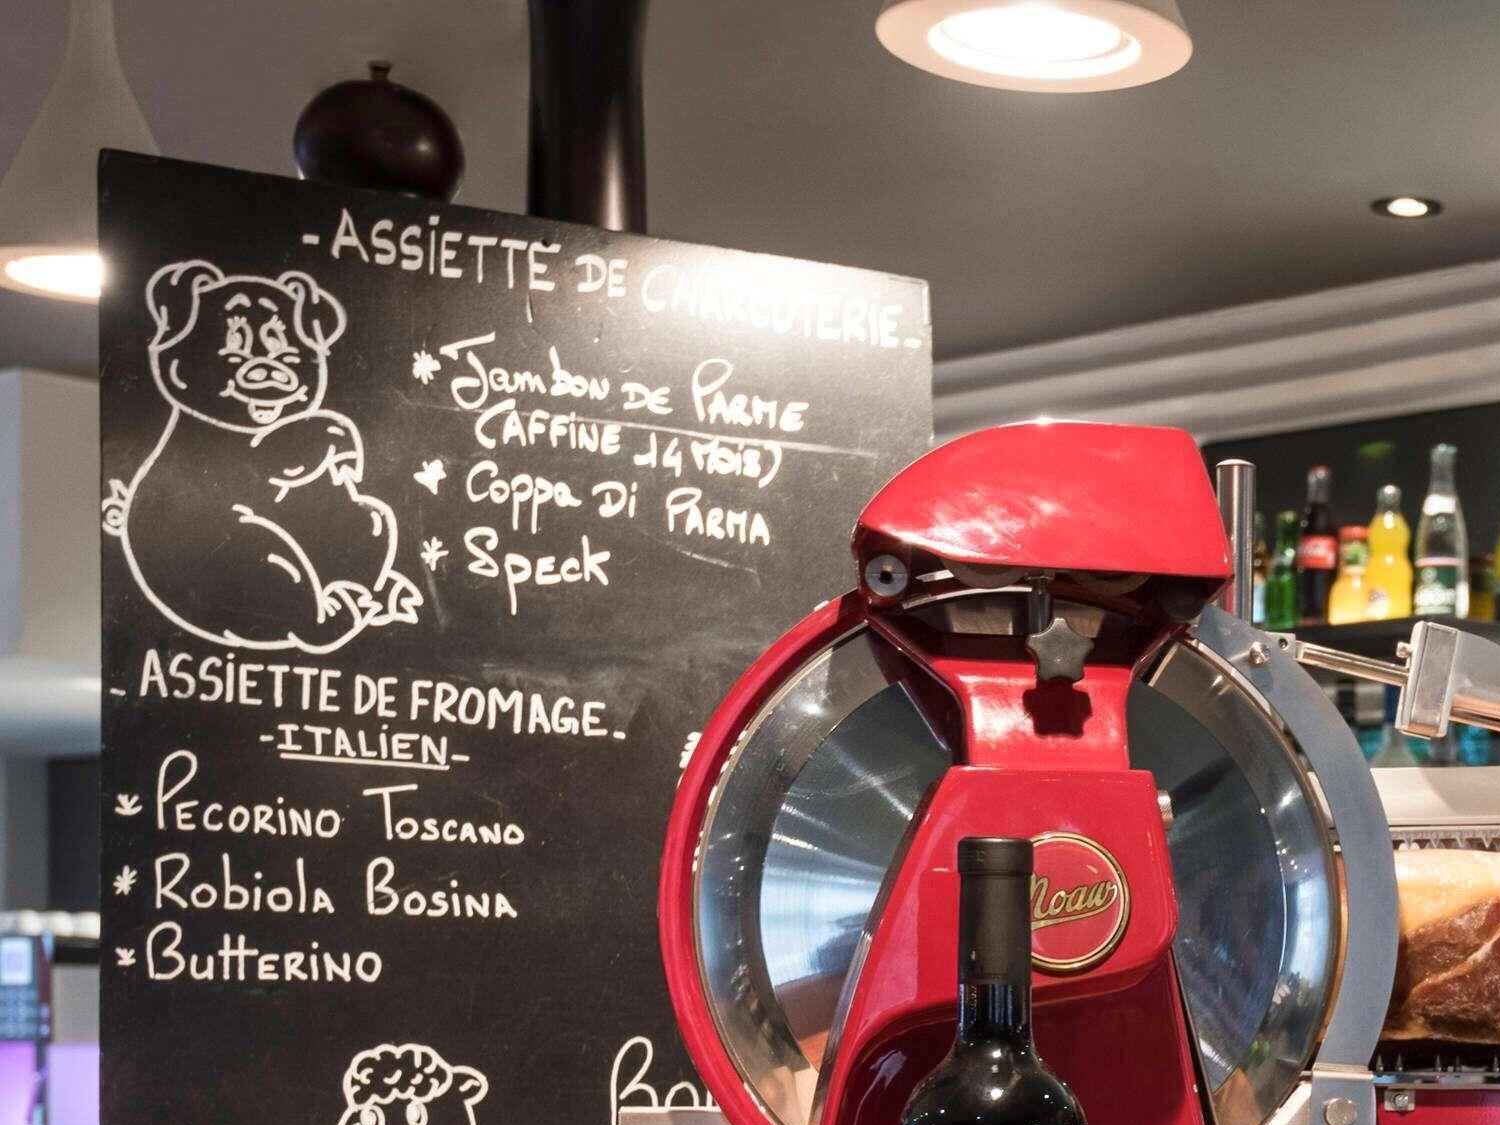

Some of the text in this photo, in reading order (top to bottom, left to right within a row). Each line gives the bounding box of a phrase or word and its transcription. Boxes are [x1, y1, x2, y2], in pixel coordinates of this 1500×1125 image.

[574, 254, 629, 298] DE
[620, 382, 674, 416] DE
[691, 358, 810, 432] PARME
[634, 432, 683, 478] 14
[466, 459, 582, 534] Coppa
[665, 486, 771, 546] PARMA
[354, 673, 399, 719] DE
[155, 852, 519, 918] Robiola BOSINA
